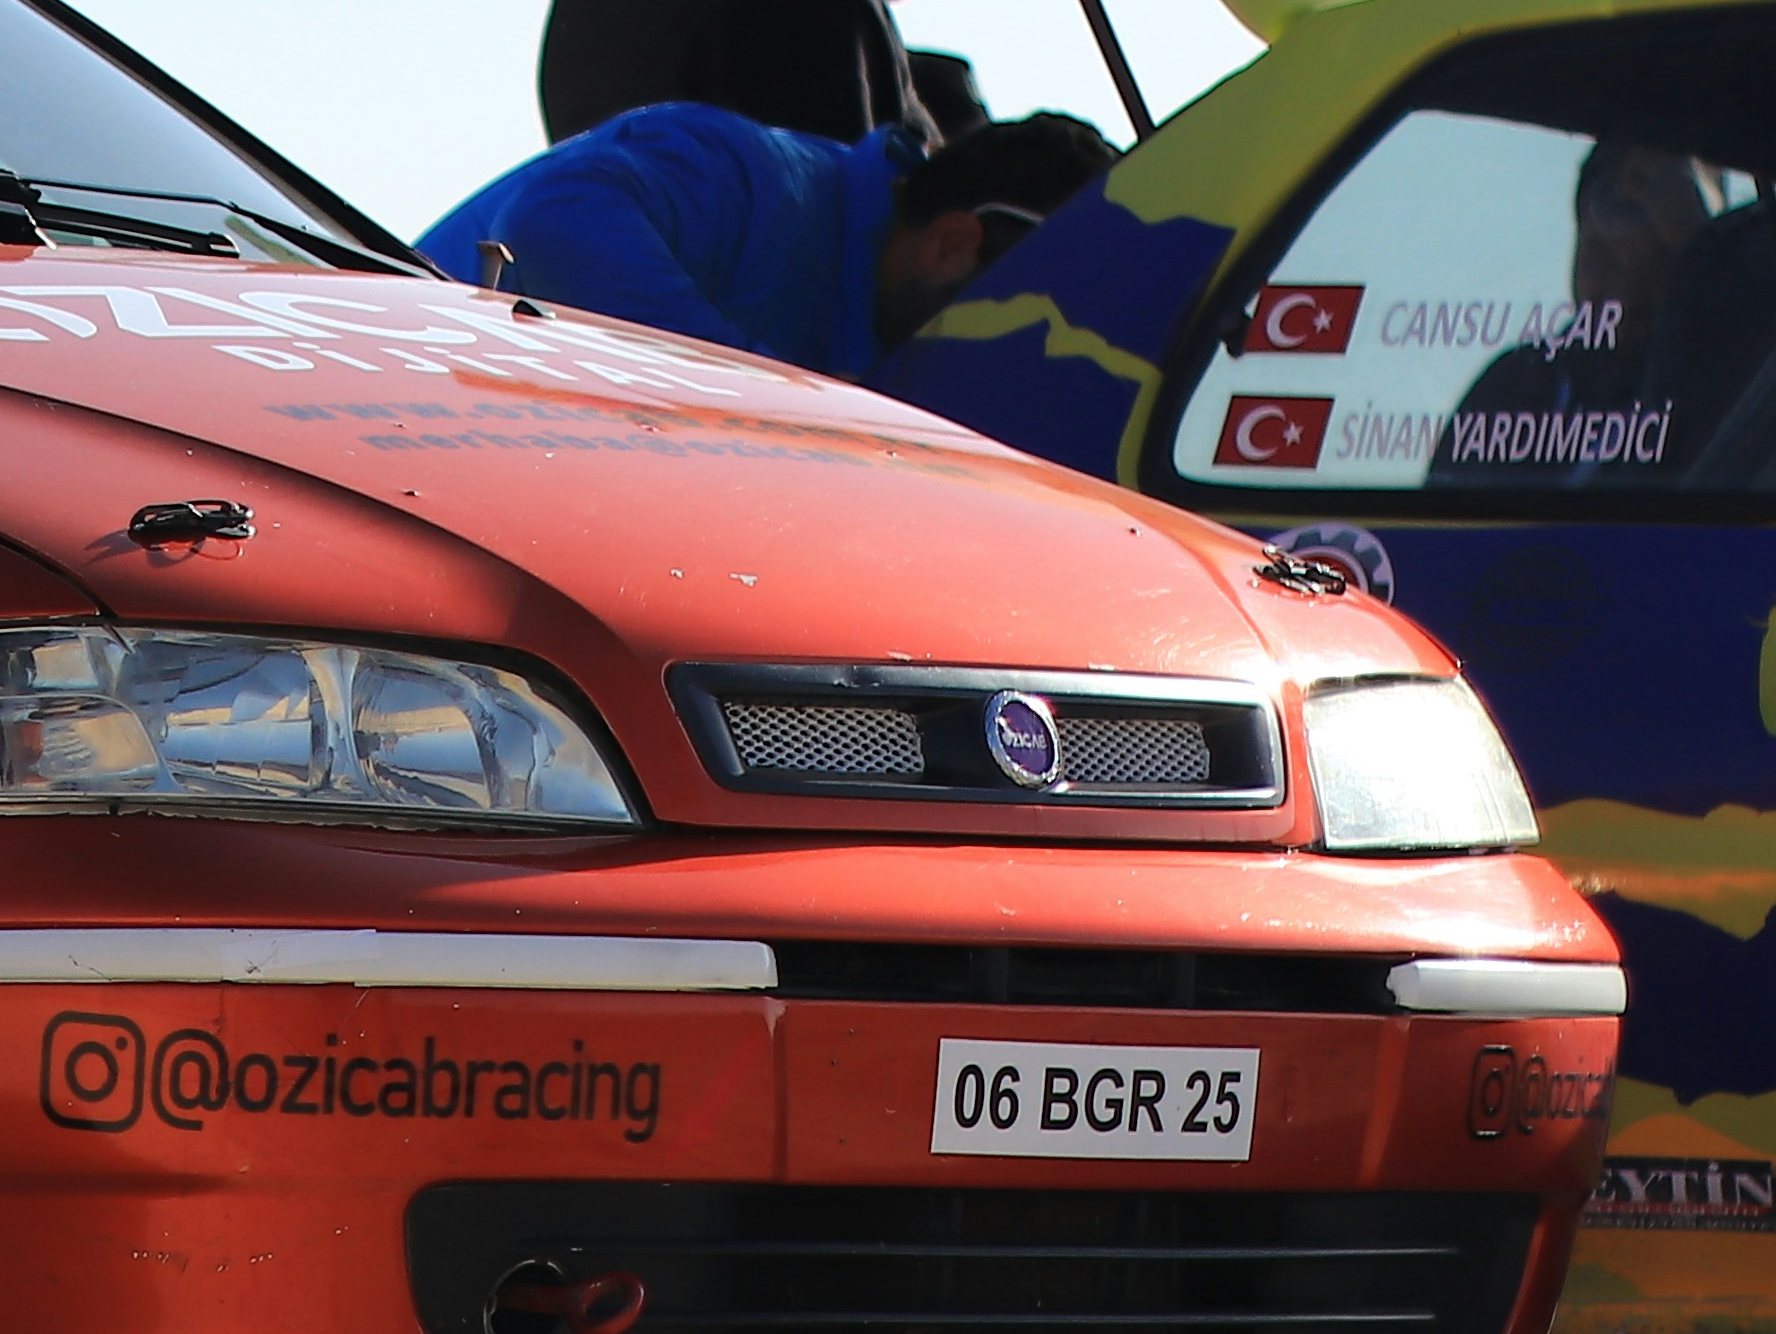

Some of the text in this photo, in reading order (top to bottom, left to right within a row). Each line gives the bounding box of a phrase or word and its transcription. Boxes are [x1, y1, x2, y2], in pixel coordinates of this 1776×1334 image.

[1381, 299, 1624, 362] CANSU AÇAR
[1336, 399, 1673, 464] SİNAN YARDIMEDİCİ
[151, 1029, 662, 1144] @ozicabracing
[954, 1063, 1242, 1136] 06 BGR 25
